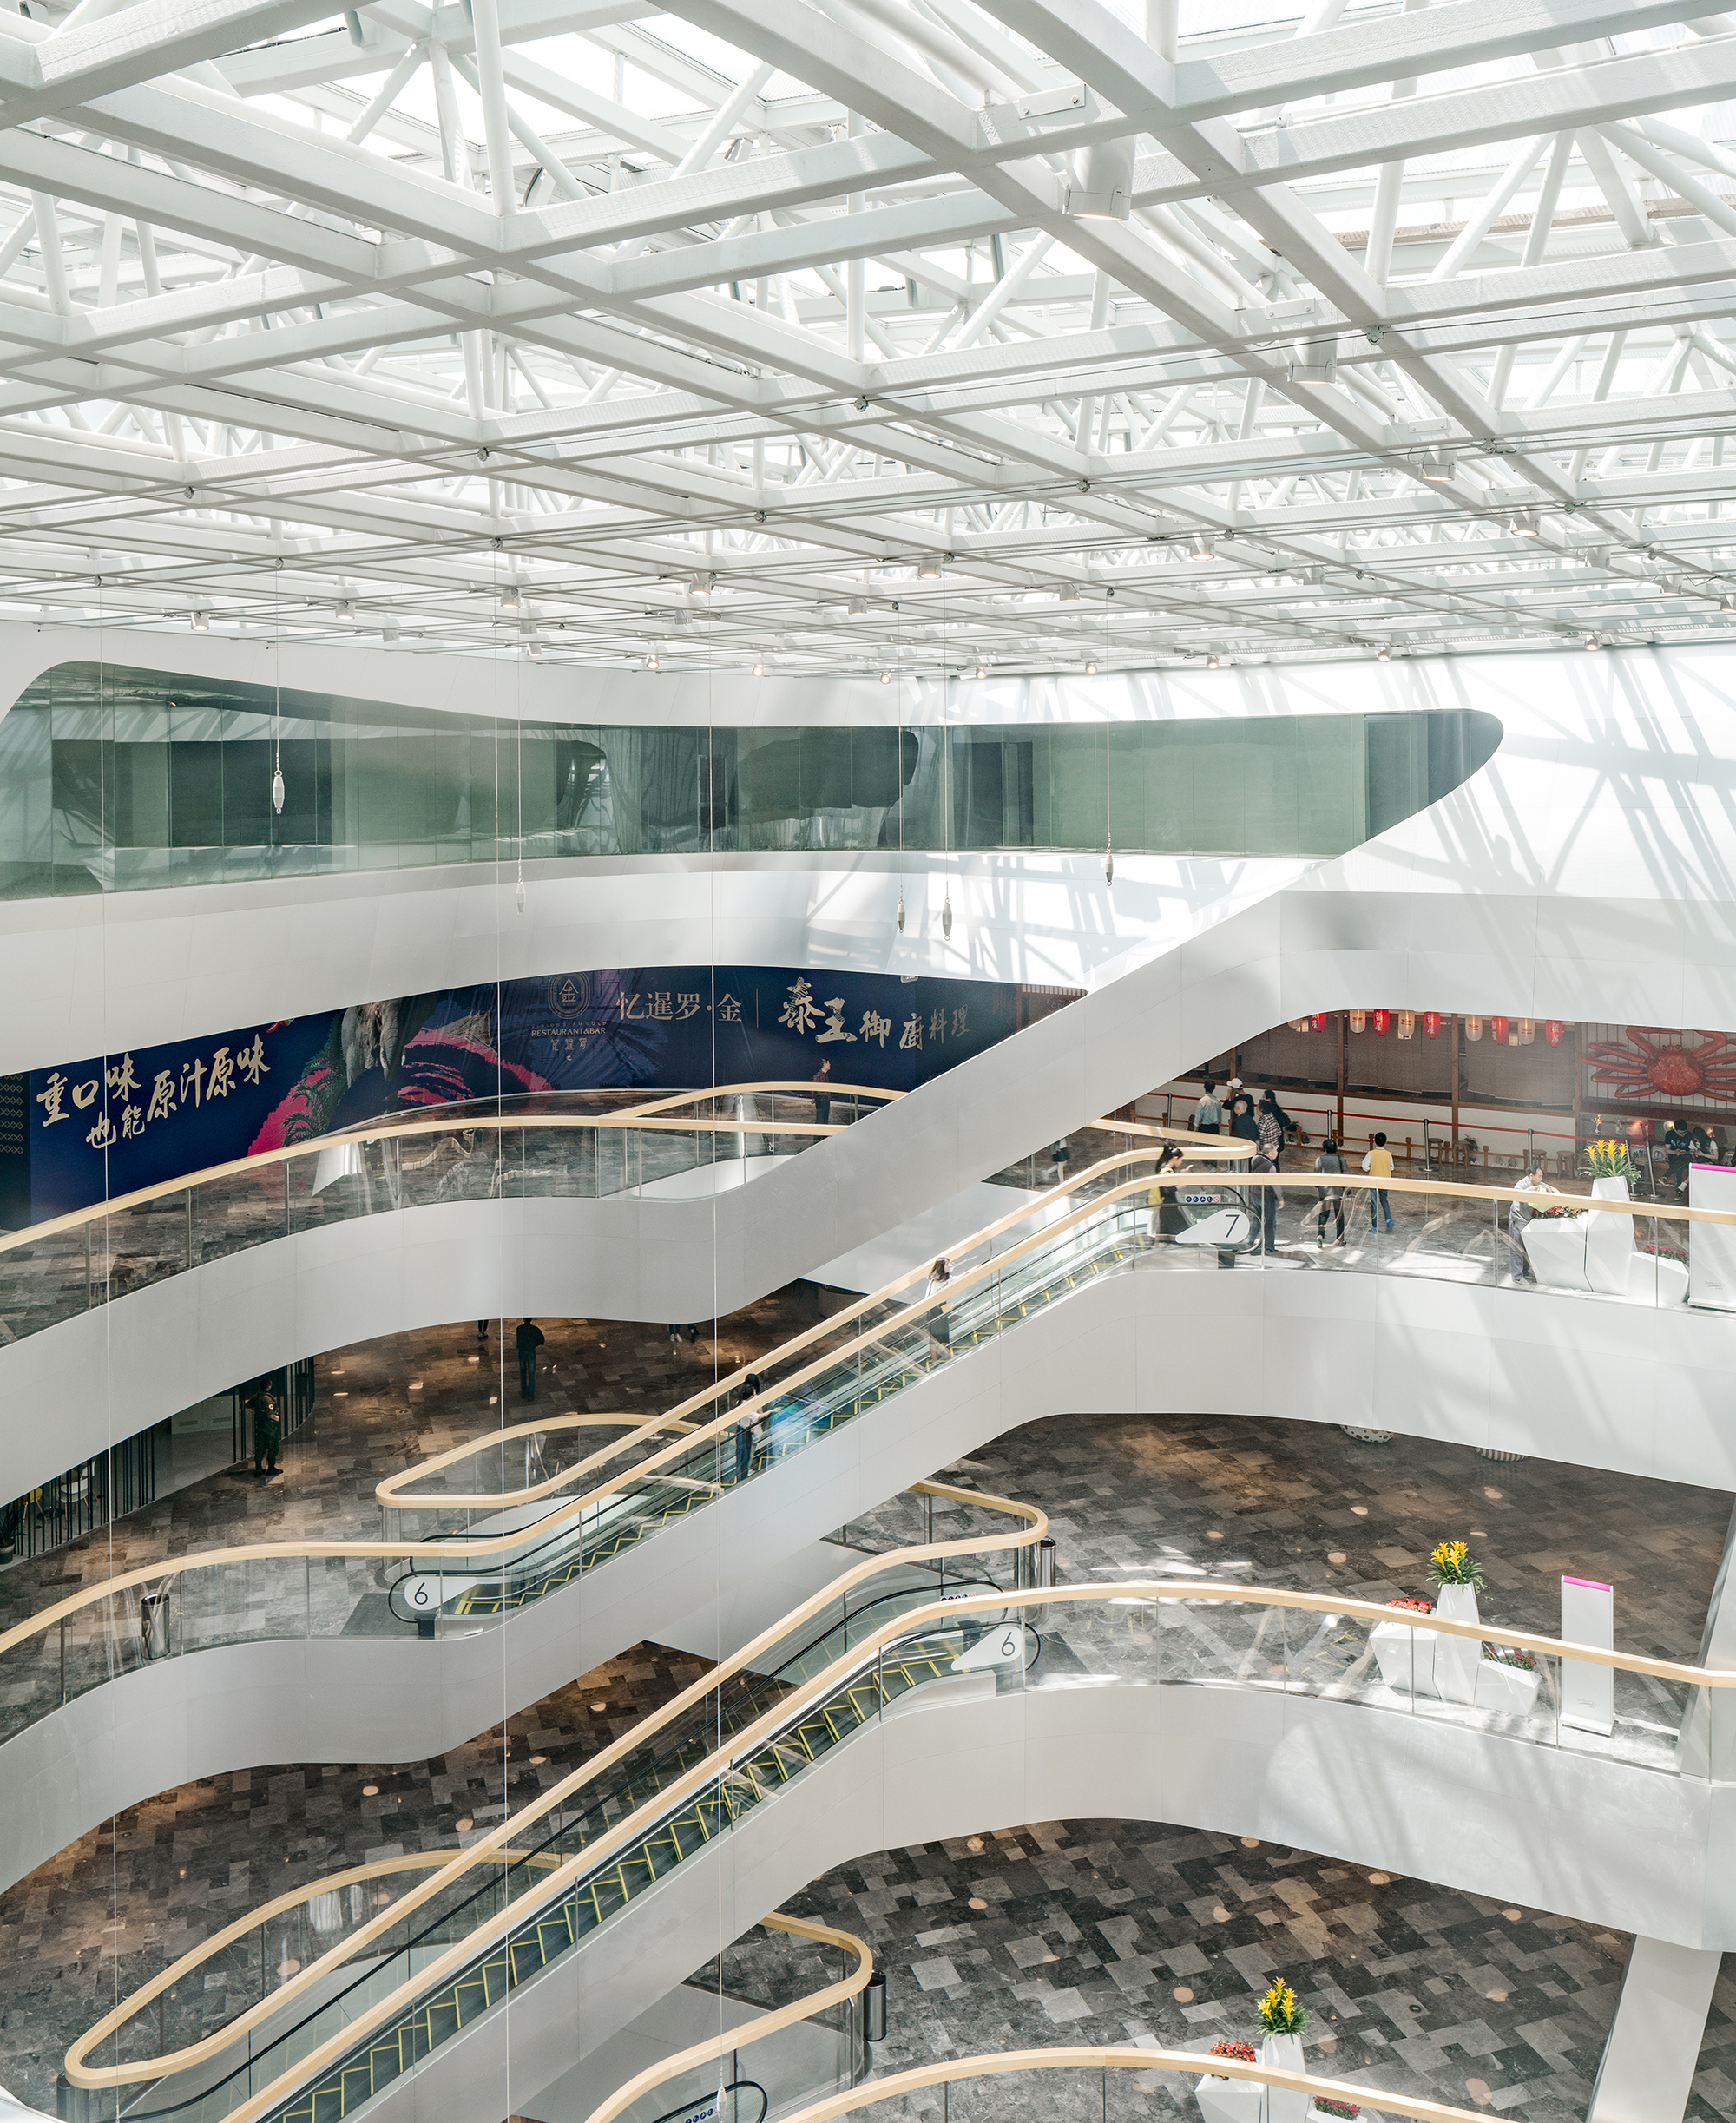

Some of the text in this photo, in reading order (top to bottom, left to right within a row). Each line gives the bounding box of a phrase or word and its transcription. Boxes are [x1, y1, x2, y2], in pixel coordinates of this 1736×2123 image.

[531, 1027, 607, 1037] RESTAURANT&BAR
[1225, 1214, 1240, 1239] 7
[414, 1581, 428, 1605] 6
[1001, 1632, 1016, 1657] 6
